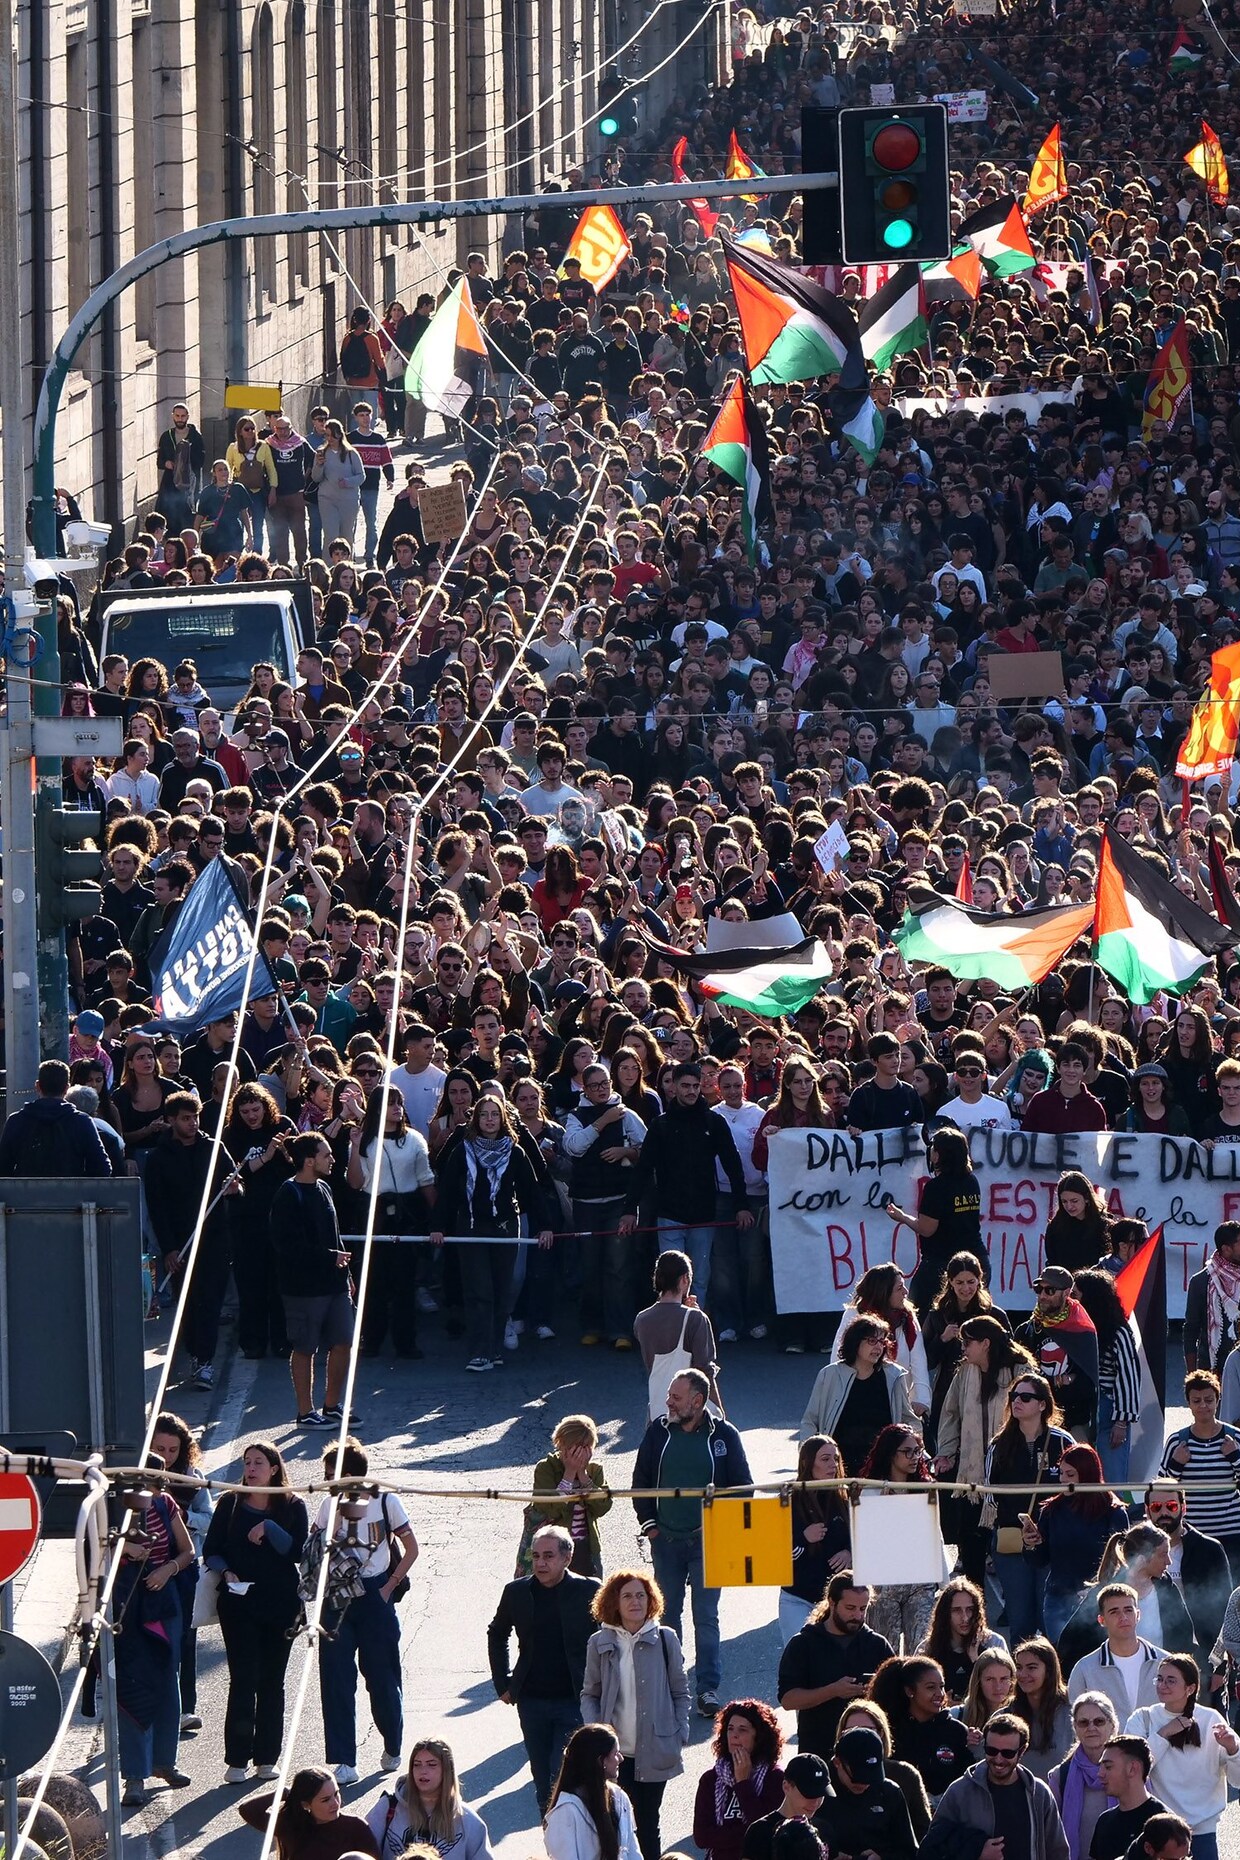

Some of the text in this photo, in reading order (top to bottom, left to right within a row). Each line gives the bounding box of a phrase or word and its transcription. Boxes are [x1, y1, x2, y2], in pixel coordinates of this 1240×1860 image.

[570, 346, 596, 359] BOSTON
[806, 1126, 925, 1176] DALLE
[968, 1126, 1081, 1173] CUOLE
[1111, 1136, 1138, 1181] E
[778, 1188, 852, 1211] con
[1135, 1206, 1153, 1223] e
[1164, 1196, 1208, 1226] la
